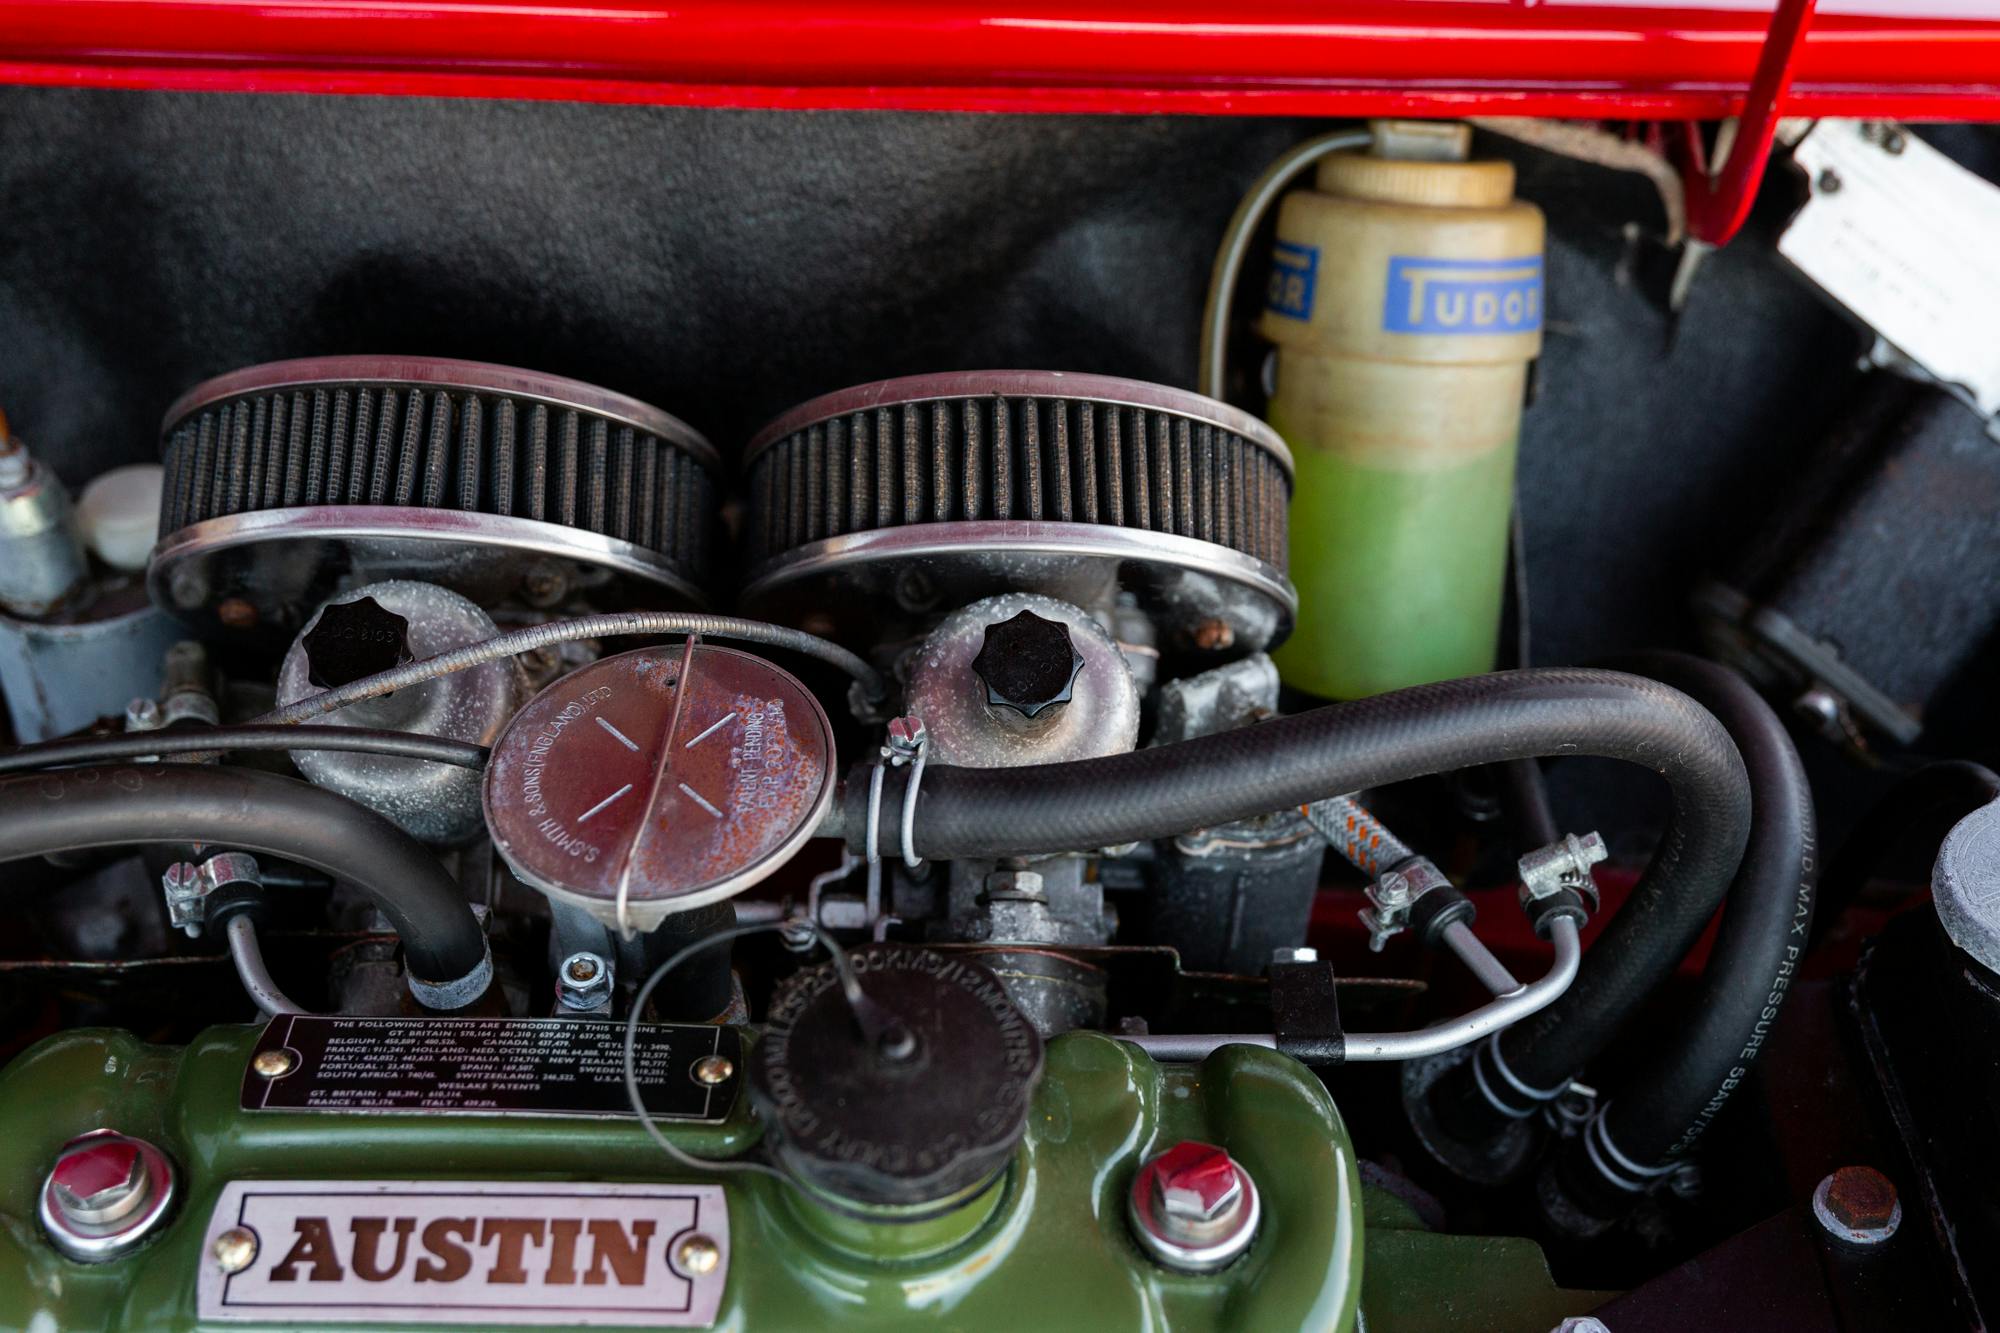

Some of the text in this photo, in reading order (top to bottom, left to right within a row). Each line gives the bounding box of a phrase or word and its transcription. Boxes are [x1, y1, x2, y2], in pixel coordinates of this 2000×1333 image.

[743, 712, 765, 760] PENDING
[1790, 883, 1812, 936] MAX
[1740, 945, 1800, 1060] PRESSURE
[358, 1021, 425, 1029] FOLLOWING
[428, 1021, 476, 1029] PATENTS
[585, 1024, 609, 1032] THIS
[499, 1047, 550, 1056] OCTROOI
[551, 1048, 570, 1056] NR.
[579, 1058, 635, 1066] ZEALAN:
[316, 1071, 357, 1079] SOUTH
[437, 1082, 541, 1091] WESLAKE PATENTS
[268, 1216, 657, 1286] AUSTIN
